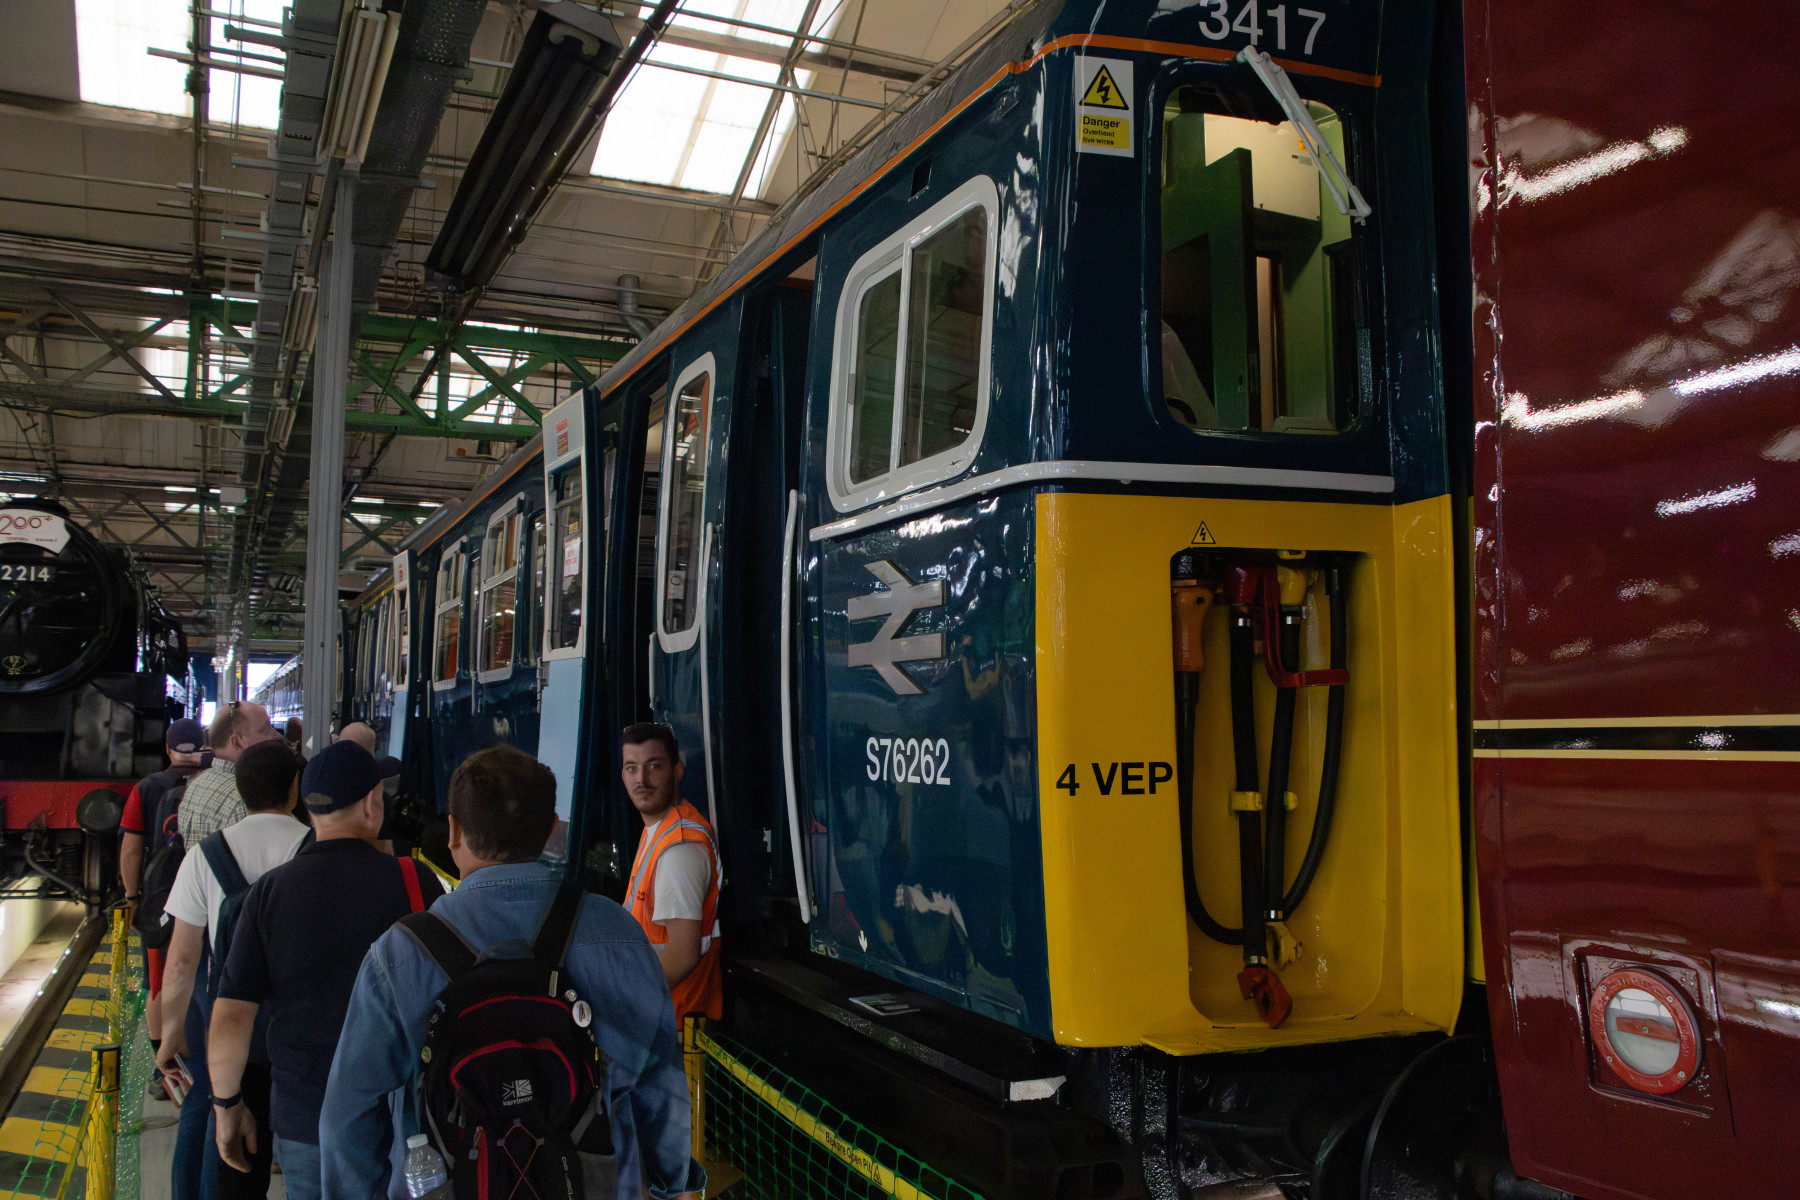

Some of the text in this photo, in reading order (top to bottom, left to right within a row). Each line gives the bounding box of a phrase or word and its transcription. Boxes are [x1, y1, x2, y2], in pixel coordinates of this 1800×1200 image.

[1198, 0, 1327, 55] 3417
[1083, 116, 1120, 129] Danger
[1083, 128, 1115, 137] Overhead
[1, 564, 50, 582] 2214
[866, 736, 951, 786] S76262
[1056, 762, 1173, 796] 4 VEP
